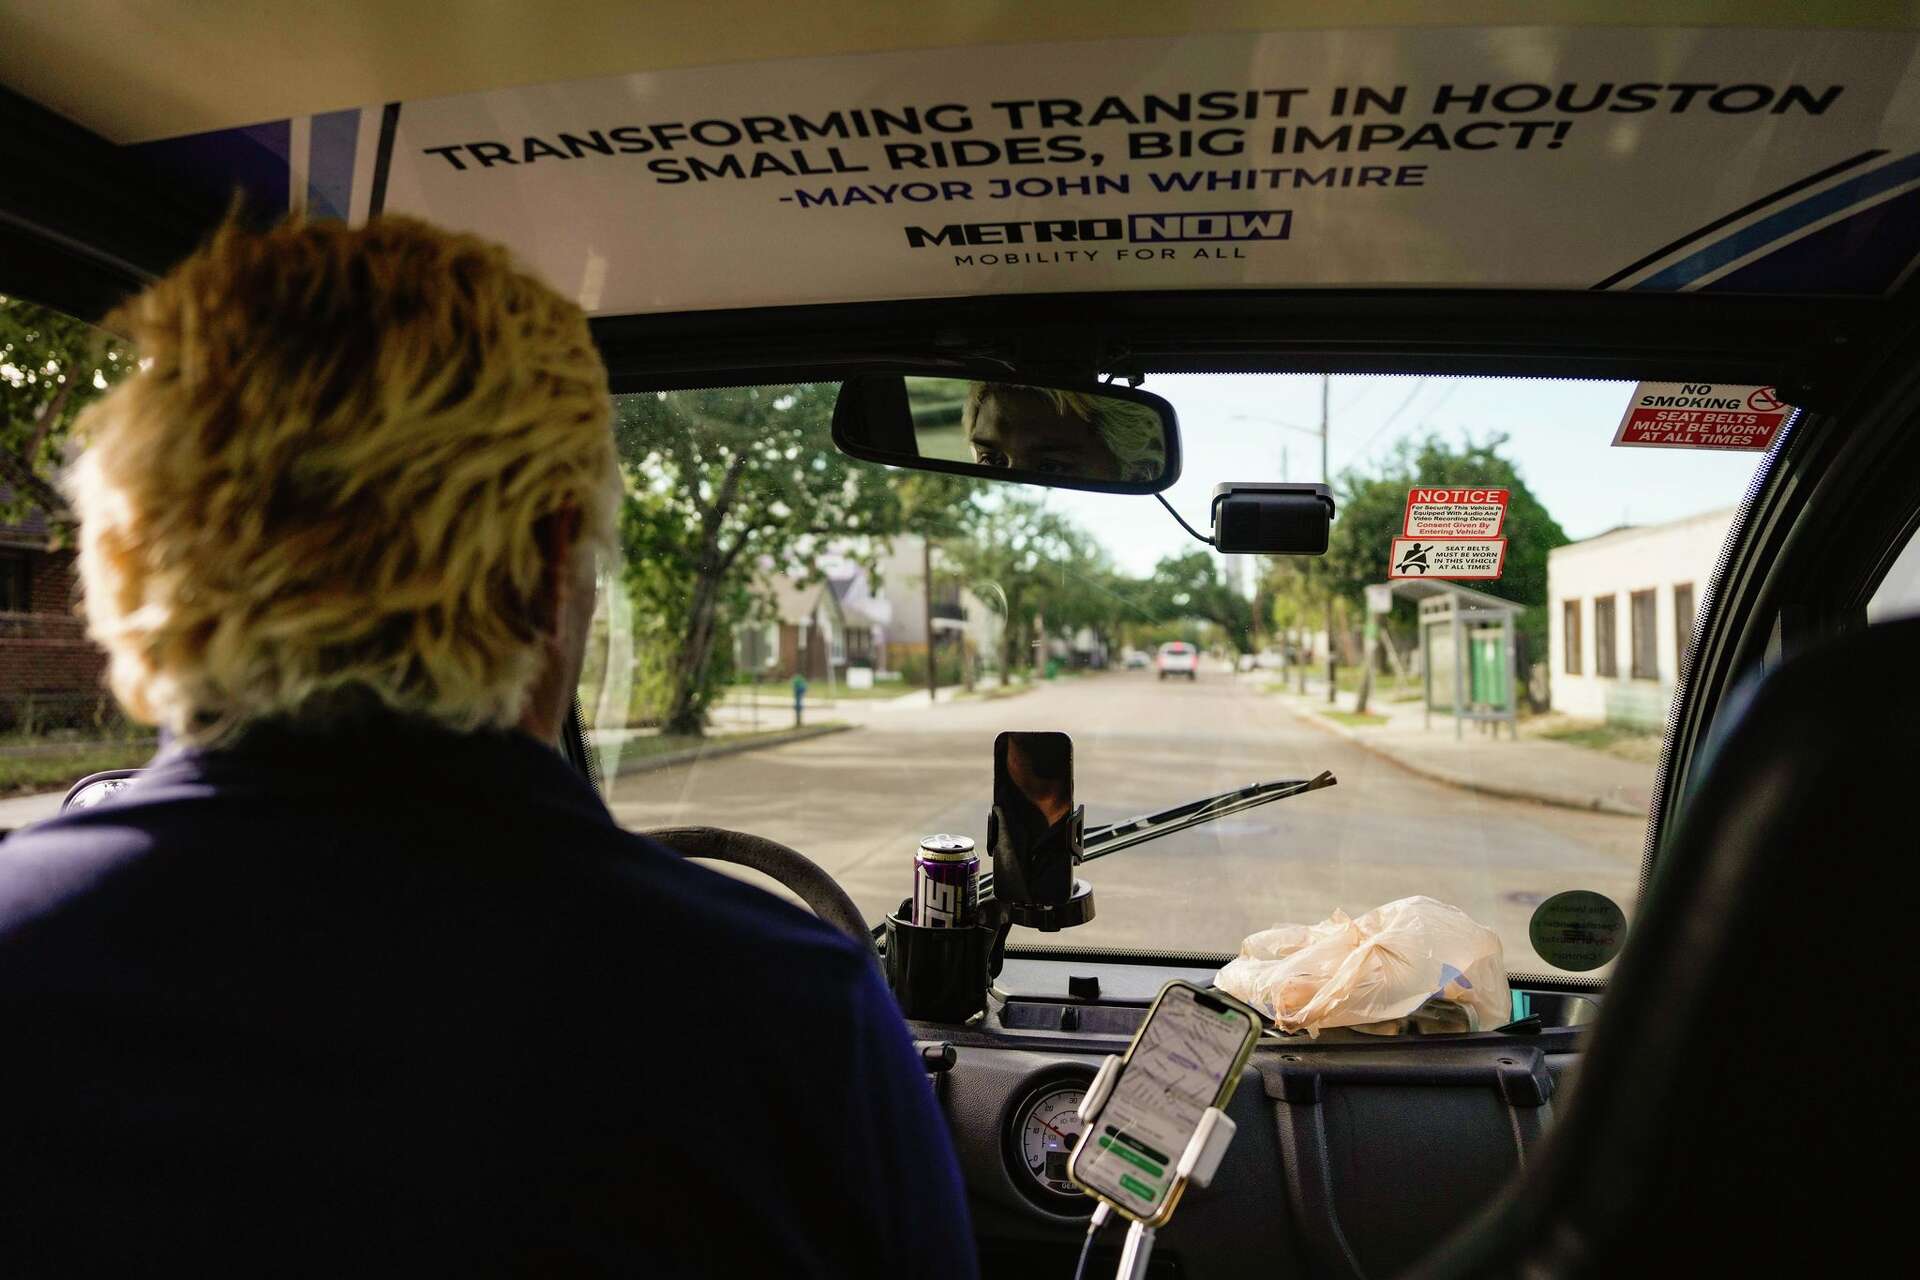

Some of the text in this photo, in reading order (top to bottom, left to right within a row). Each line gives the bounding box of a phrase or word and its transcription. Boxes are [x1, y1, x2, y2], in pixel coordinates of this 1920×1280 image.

[424, 83, 1844, 170] TRANSFORMING TRANSIT IN HOUSTON
[647, 121, 1573, 184] SMALL RIDES, BIG IMPACT!
[779, 165, 1429, 209] -MAYOR JOHN WHITMIRE
[905, 211, 1287, 248] METRO NOW
[954, 247, 1247, 266] MOBILITY FOR ALL
[1681, 384, 1712, 396] NO
[1640, 396, 1741, 409] SMOKING
[1655, 411, 1757, 424] SEAT BELTS
[1633, 421, 1770, 435] MUST BE WORN
[1639, 431, 1753, 445] AT ALL TIMES
[1417, 490, 1500, 502] NOTICE
